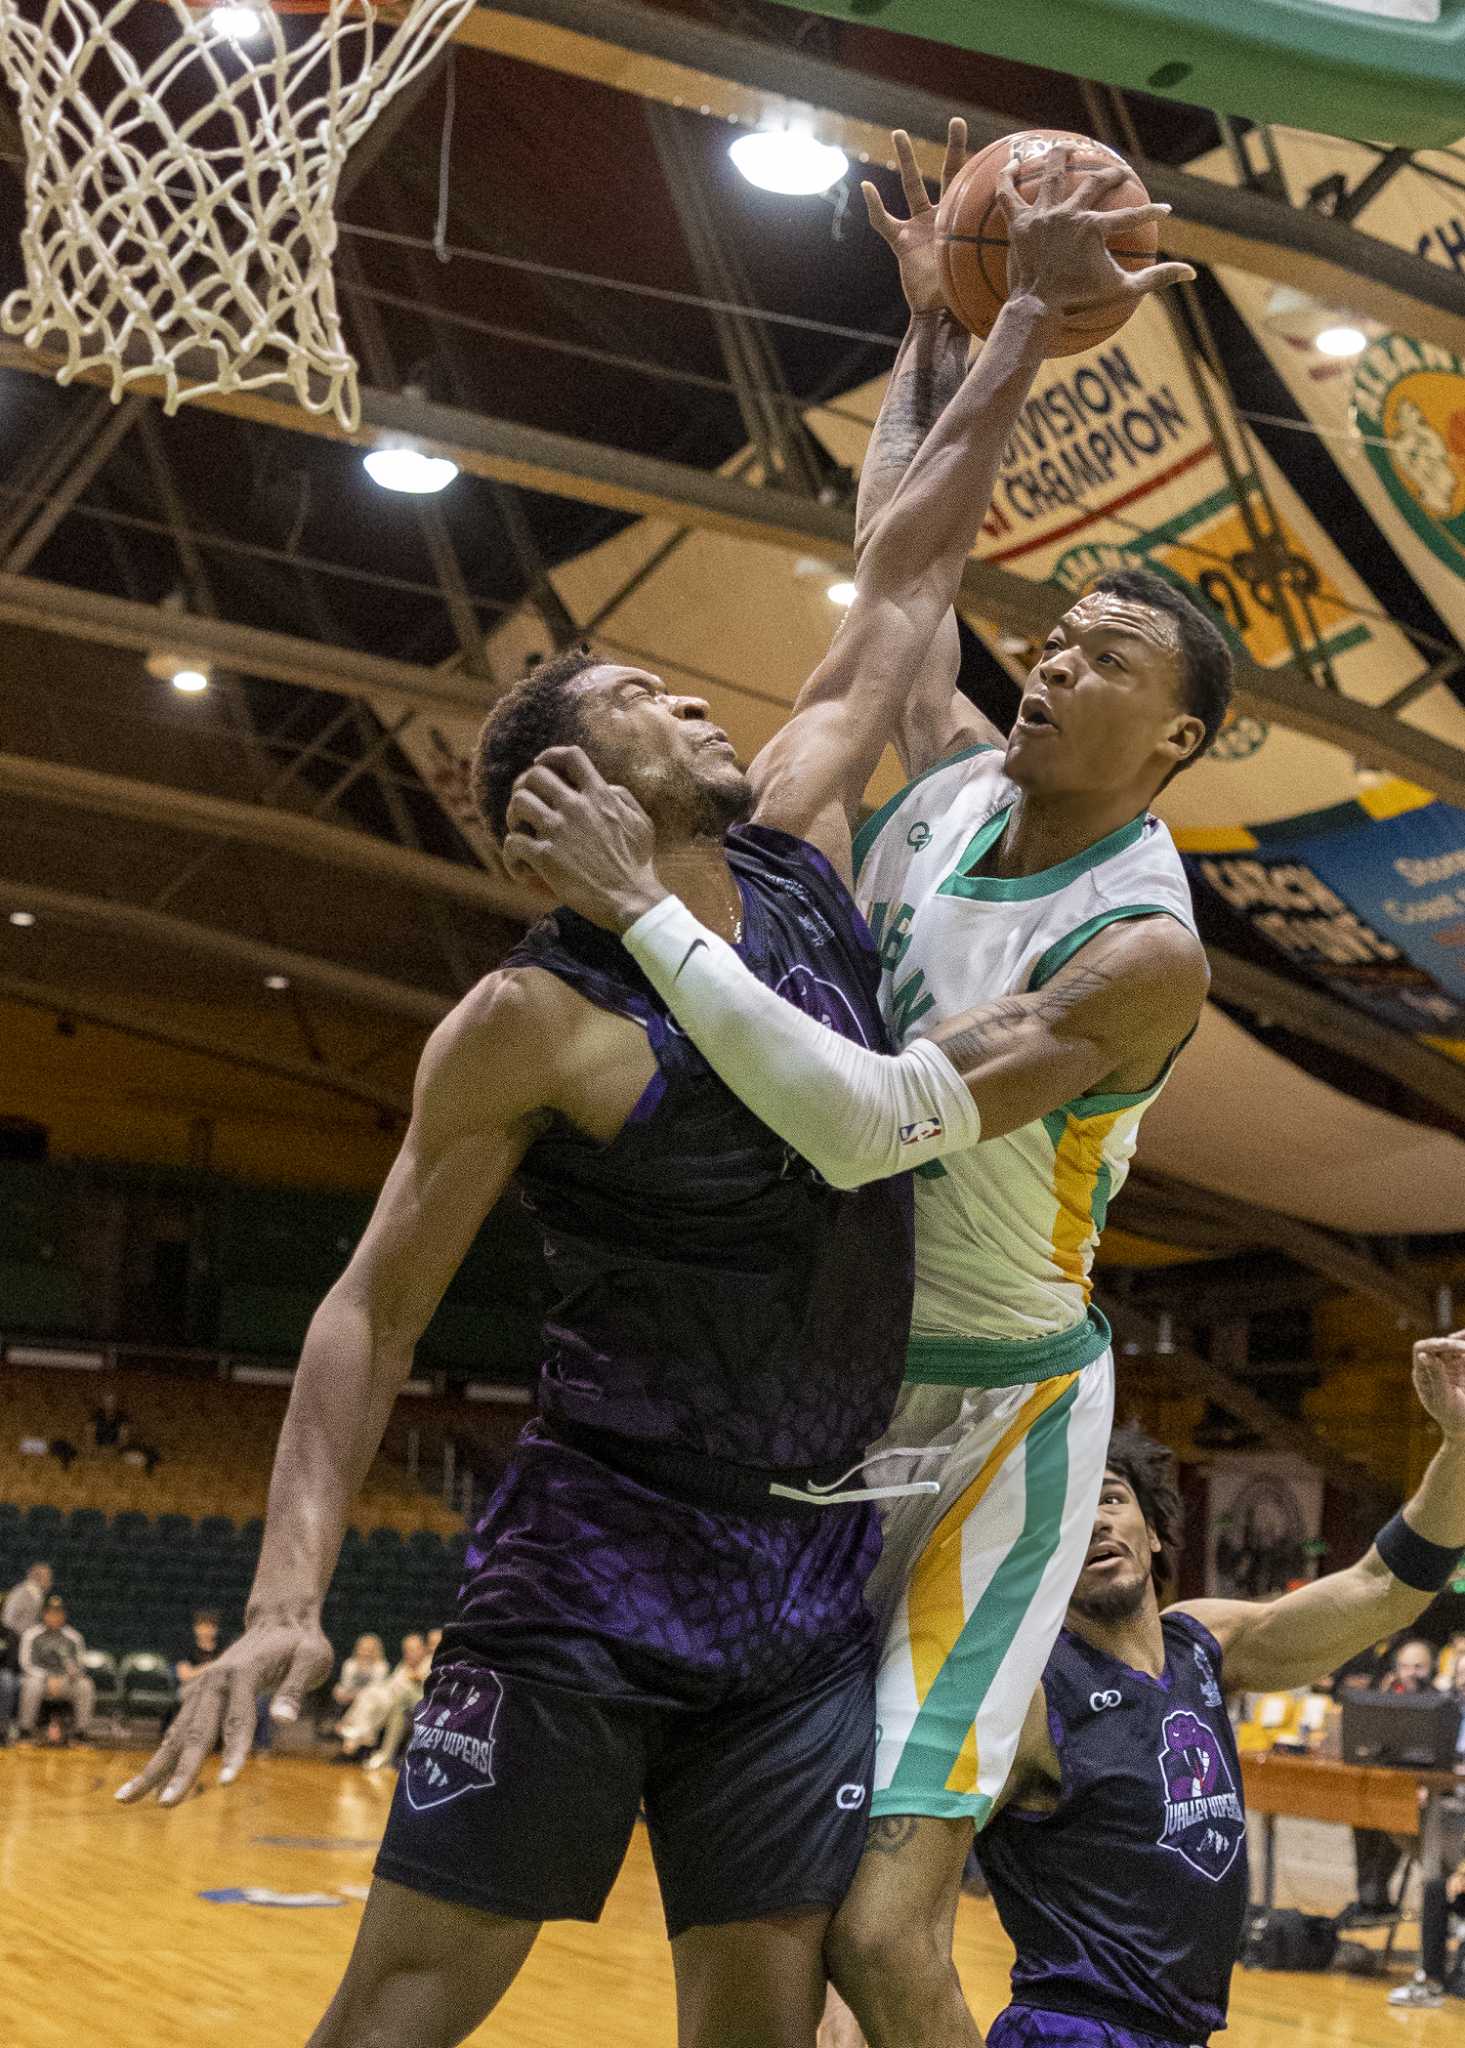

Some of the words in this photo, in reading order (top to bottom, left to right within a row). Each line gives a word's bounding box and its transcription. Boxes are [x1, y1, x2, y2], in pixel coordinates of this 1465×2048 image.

[1004, 385, 1189, 519] CHAMPION
[443, 1731, 489, 1775] VIPERS
[1168, 1798, 1209, 1836] VALLEY
